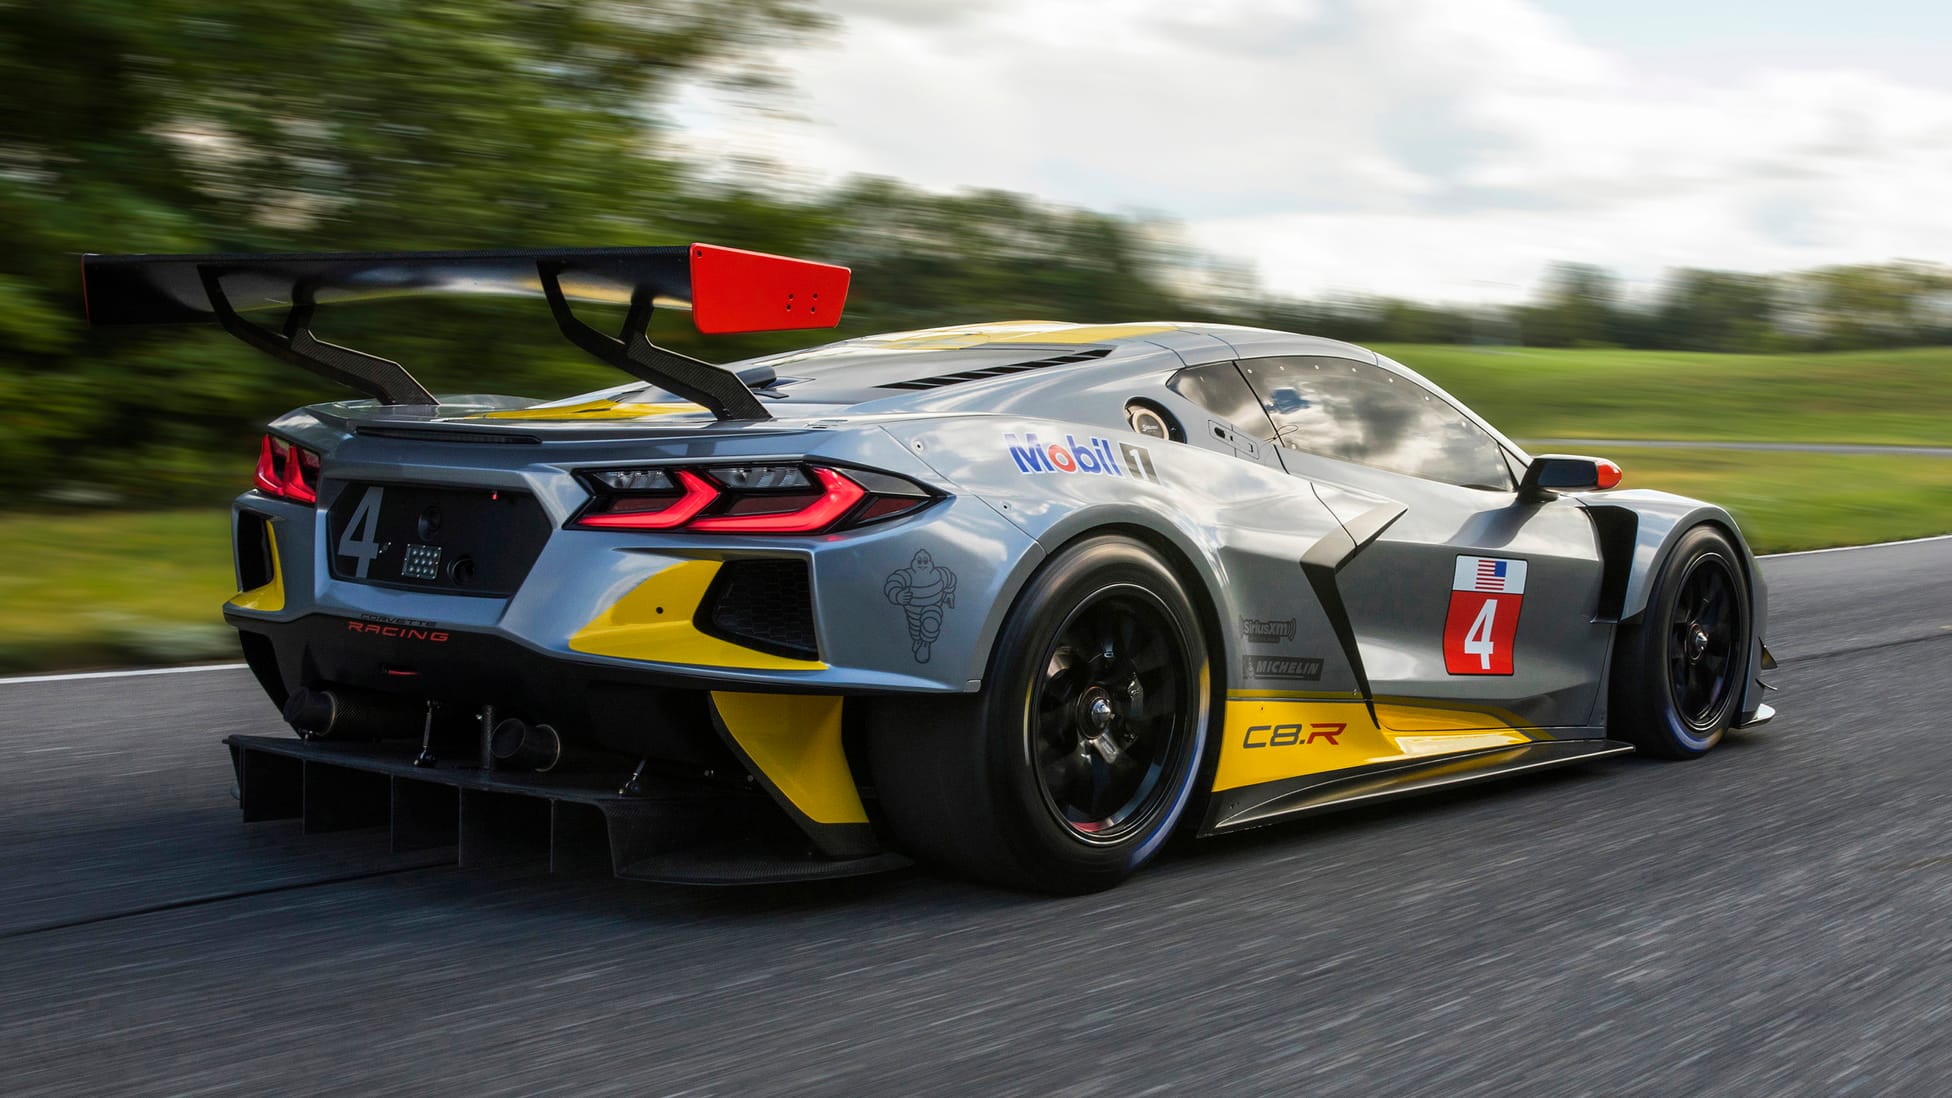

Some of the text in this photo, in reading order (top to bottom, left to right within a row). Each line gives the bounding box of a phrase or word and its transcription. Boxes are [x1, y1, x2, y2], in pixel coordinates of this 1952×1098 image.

[1004, 432, 1124, 476] Mobil
[337, 486, 384, 578] 4
[347, 621, 449, 642] RACING
[1464, 599, 1498, 670] 4
[1256, 660, 1320, 674] MICHELIN
[1243, 723, 1347, 749] C8.R
